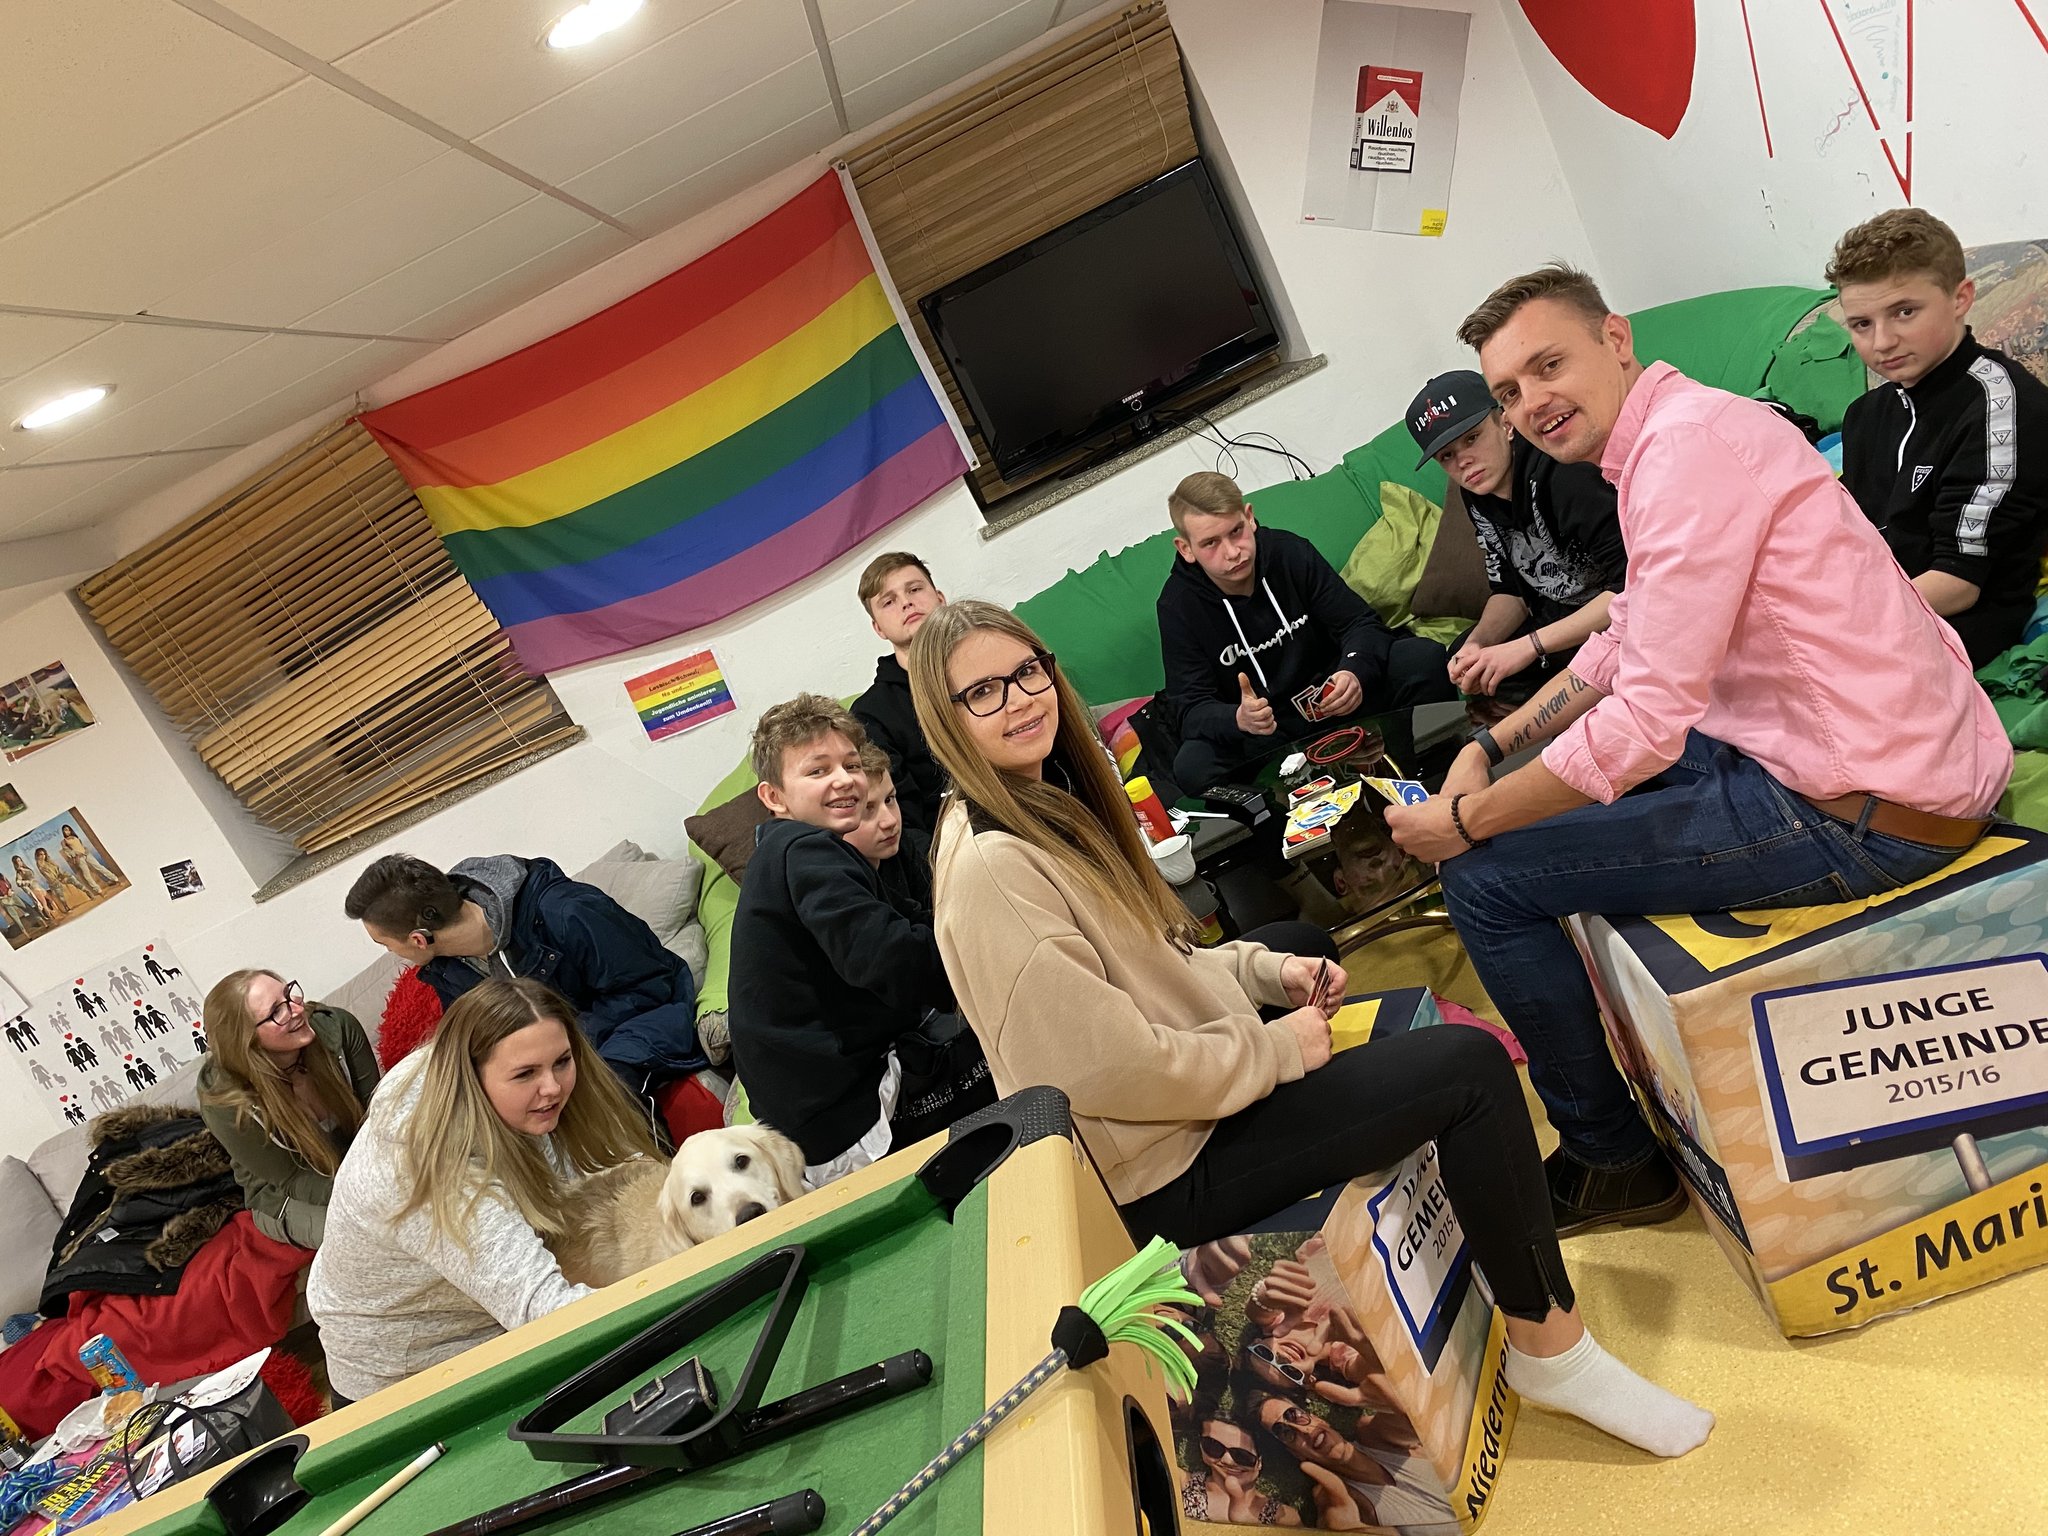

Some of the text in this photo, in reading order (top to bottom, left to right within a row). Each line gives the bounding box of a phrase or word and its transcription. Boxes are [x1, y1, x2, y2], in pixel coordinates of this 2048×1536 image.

[1368, 114, 1413, 139] Willenlos
[1219, 614, 1309, 666] Champon
[651, 687, 717, 716] Jugendliche animieren
[1843, 987, 1995, 1036] JUNGE
[1799, 1017, 2048, 1087] GEMEINDE
[1885, 1064, 2001, 1104] 2015/16
[1826, 1182, 2048, 1316] St. Mari
